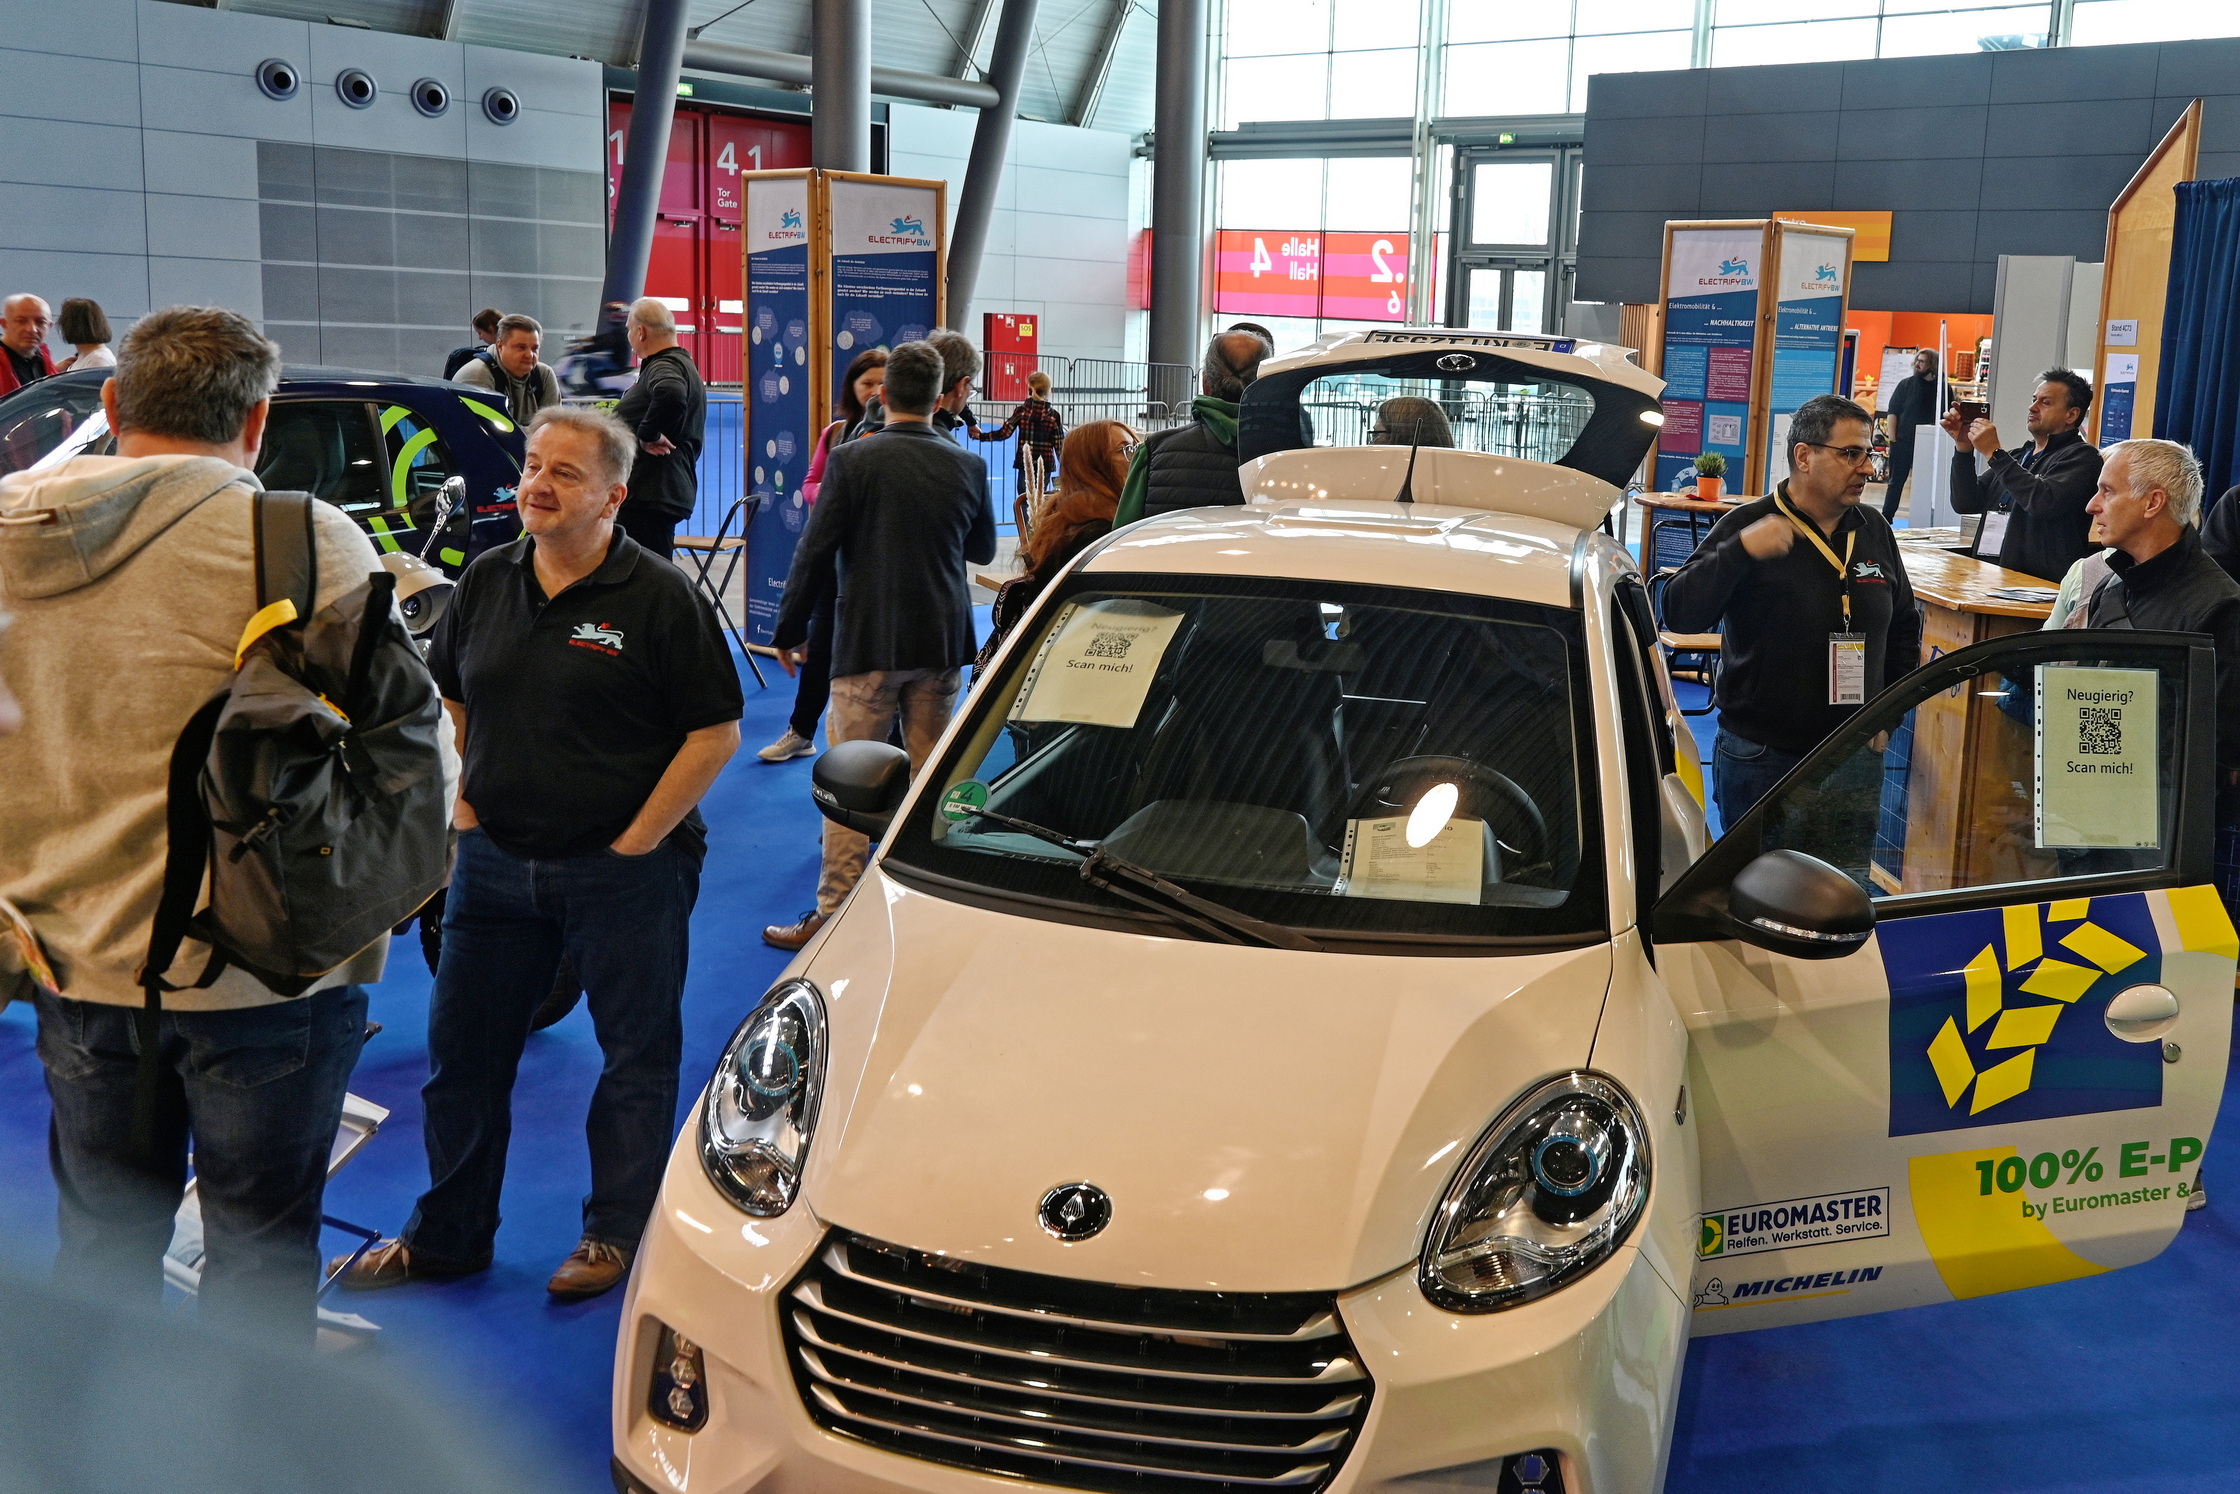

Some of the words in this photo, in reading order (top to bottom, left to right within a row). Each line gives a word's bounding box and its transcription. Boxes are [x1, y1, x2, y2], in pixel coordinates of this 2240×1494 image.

[717, 187, 731, 198] Tor
[717, 198, 738, 209] Gate
[1066, 659, 1096, 670] Scan
[1098, 662, 1134, 673] mich!
[2066, 688, 2134, 706] Neugierig?
[2066, 760, 2097, 774] Scan
[2100, 761, 2134, 775] mich!
[1975, 1145, 2104, 1196] 100%
[2118, 1136, 2203, 1179] E-P
[2021, 1200, 2049, 1221] by
[2052, 1186, 2171, 1214] Euromaster
[2175, 1181, 2191, 1199] &
[1727, 1194, 1883, 1237] EUROMASTER
[1727, 1235, 1769, 1250] Reifen.
[1771, 1227, 1833, 1244] Werkstatt.
[1835, 1220, 1883, 1236] Service.
[1732, 1265, 1884, 1299] MICHELIN
